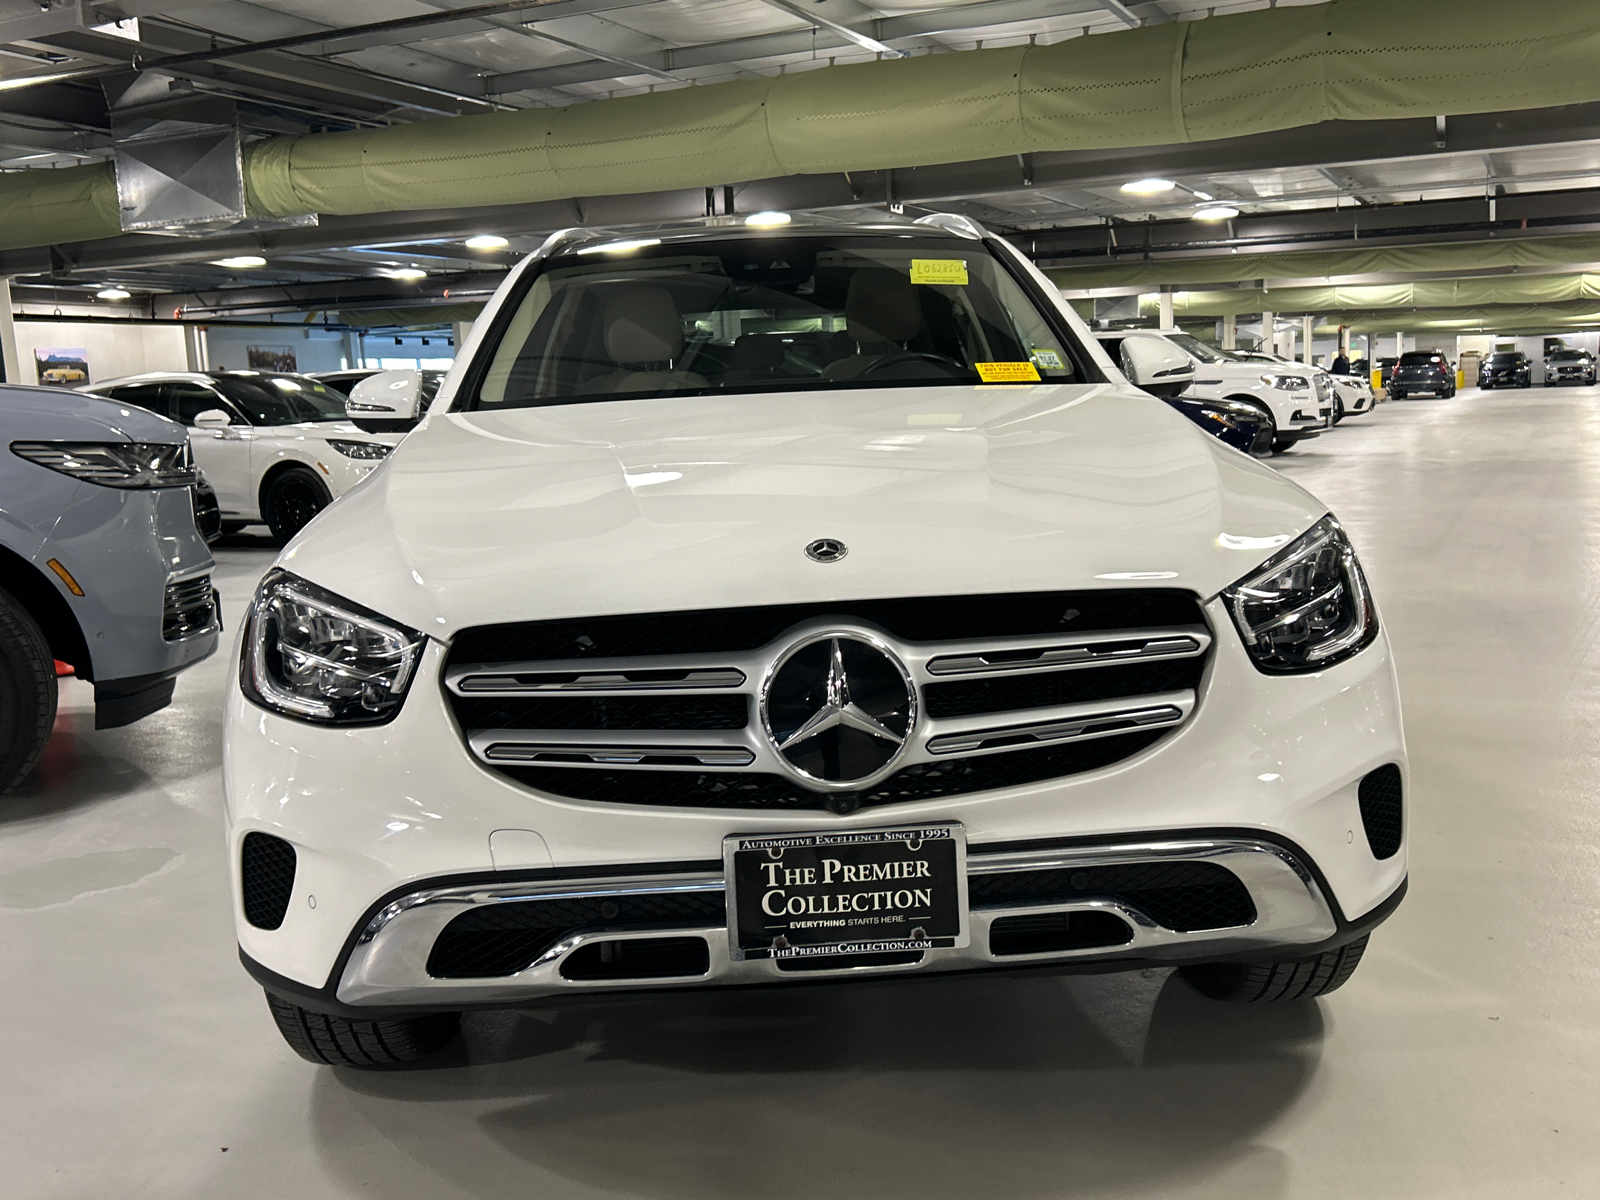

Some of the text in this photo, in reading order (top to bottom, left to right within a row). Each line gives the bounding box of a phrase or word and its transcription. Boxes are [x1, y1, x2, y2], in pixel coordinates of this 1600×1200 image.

[742, 829, 949, 850] AUTOMOTIVE EXCELLENCE SINCE 1995
[760, 859, 932, 888] THE PREMIER
[761, 888, 933, 917] COLLECTION
[789, 915, 906, 929] EVERYTHING STARTS HERE.
[767, 940, 933, 959] THEPREMIERCOLLECTION.COM
